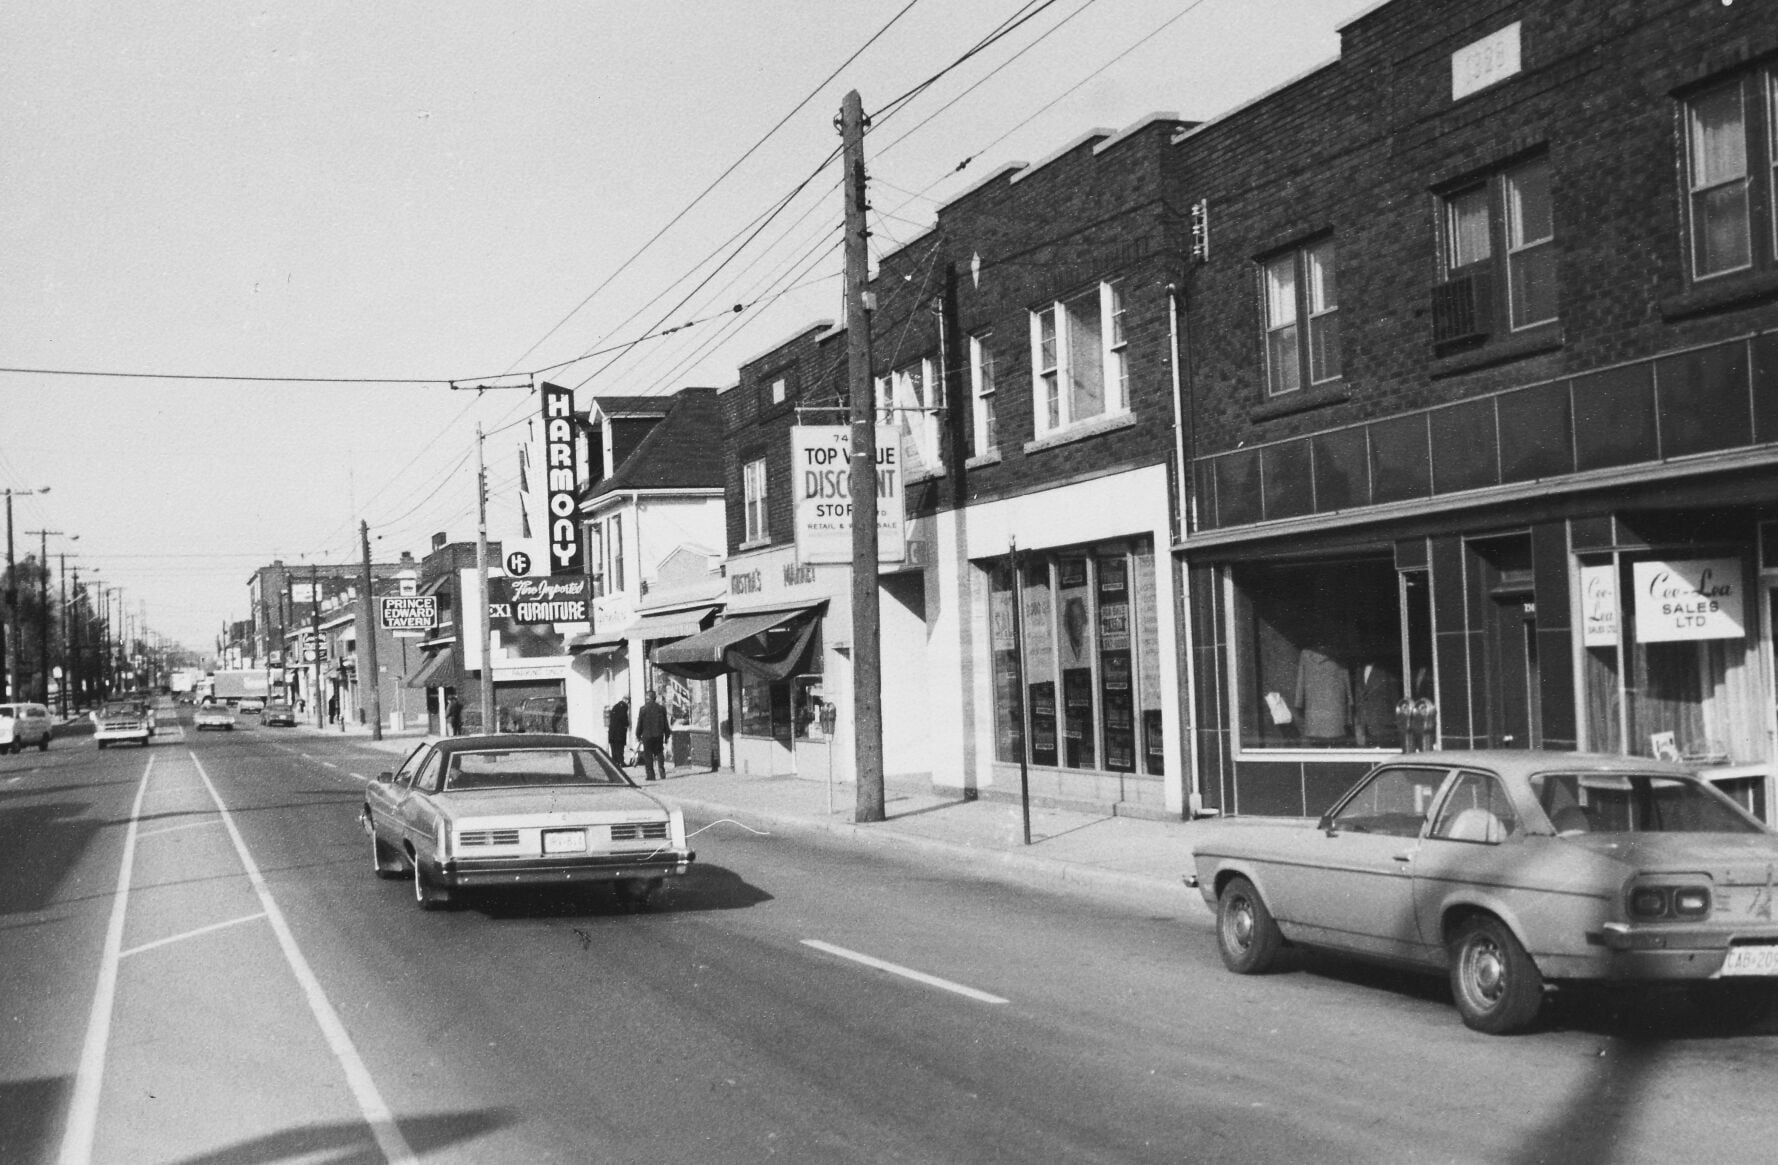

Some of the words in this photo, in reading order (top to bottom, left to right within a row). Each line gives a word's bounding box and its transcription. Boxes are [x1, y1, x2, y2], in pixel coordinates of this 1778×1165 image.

[805, 448, 837, 464] TOP
[842, 447, 895, 464] VUE
[547, 393, 577, 567] HARMONY
[805, 469, 896, 499] DISCNT
[512, 580, 539, 602] Fine
[529, 580, 585, 601] Imported
[386, 599, 432, 609] PRINCE
[517, 601, 586, 622] FURNITURE
[1662, 601, 1719, 615] SALES
[384, 608, 434, 618] EDWARD
[386, 617, 431, 627] TAVERN
[1676, 616, 1706, 628] LTD
